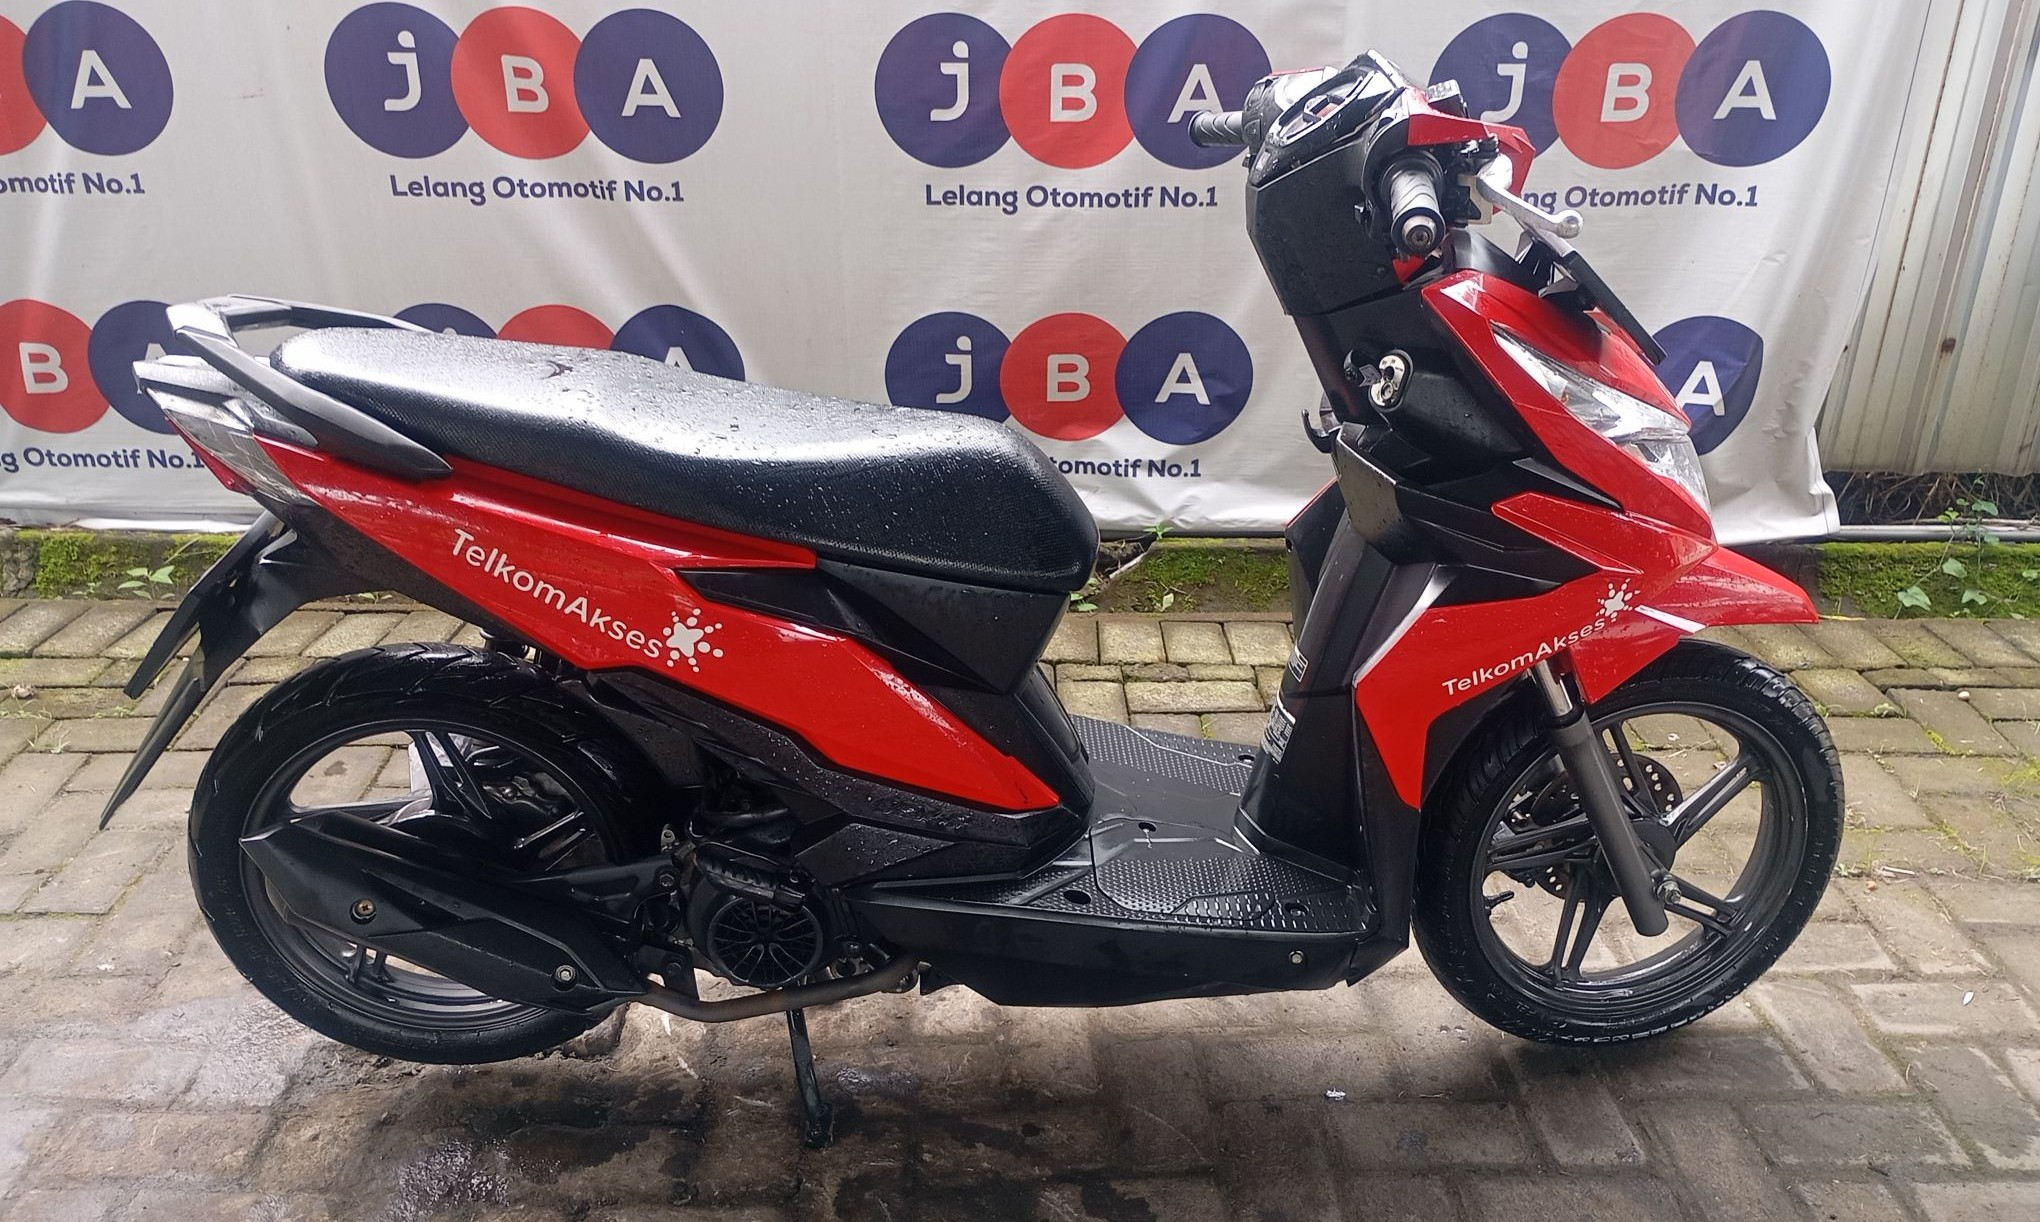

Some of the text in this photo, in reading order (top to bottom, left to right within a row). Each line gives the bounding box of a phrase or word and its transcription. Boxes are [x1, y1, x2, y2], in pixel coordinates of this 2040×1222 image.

[0, 172, 146, 195] omotif No.1
[389, 174, 685, 206] Lelang Otomotif No.1
[1564, 183, 1691, 208] Otomotif
[1695, 183, 1759, 207] No.1
[925, 184, 1218, 216] Lelang Otomotif No.1
[23, 446, 141, 468] Otomotif
[147, 449, 204, 469] No.1
[1049, 456, 1202, 478] omotif No.1
[451, 528, 663, 659] TelkomAkses
[1442, 617, 1606, 697] TelkomAkses
